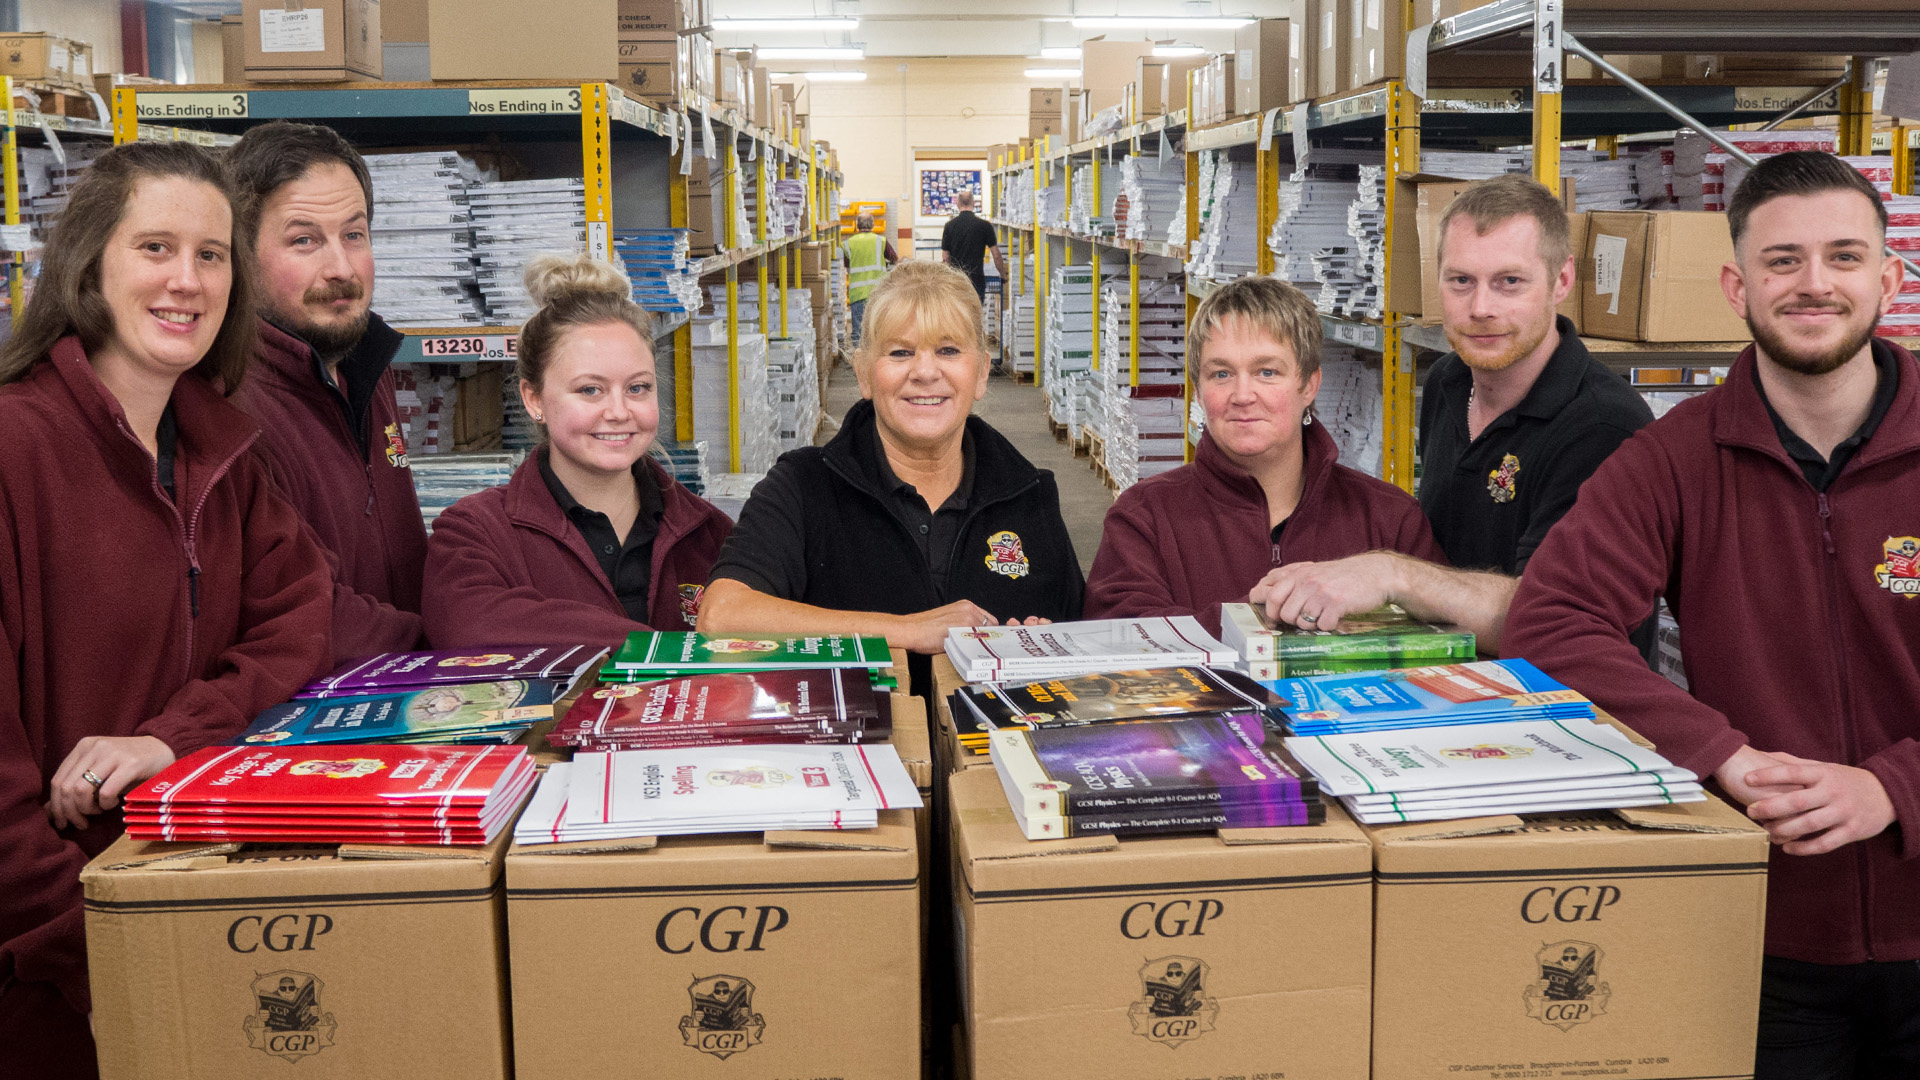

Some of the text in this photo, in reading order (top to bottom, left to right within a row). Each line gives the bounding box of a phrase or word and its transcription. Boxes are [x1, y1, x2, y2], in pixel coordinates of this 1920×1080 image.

[217, 106, 230, 115] in
[232, 94, 246, 116] 3
[469, 90, 582, 114] Nos Ending in 3
[1825, 89, 1838, 108] 3
[424, 338, 484, 354] 13230
[1000, 562, 1024, 574] CGP
[1310, 646, 1332, 654] Biology
[640, 684, 674, 724] GCSE English
[252, 758, 292, 776] Maths
[1381, 746, 1425, 770] Biology
[418, 768, 448, 790] Targeted
[642, 764, 664, 800] KS2 English
[672, 766, 698, 796] Spelling
[801, 766, 825, 786] Year 3
[1074, 761, 1108, 790] GCSE AQA
[1104, 766, 1135, 790] Physics
[842, 782, 861, 801] Targeted
[1094, 800, 1117, 808] Physics
[1099, 822, 1121, 830] Physics
[1141, 818, 1171, 827] Complete
[1520, 885, 1621, 924] CGP
[1120, 899, 1224, 940] CGP
[227, 914, 334, 954] CGP
[655, 906, 789, 954] CGP
[1546, 1004, 1589, 1021] CGP
[1152, 1020, 1197, 1038] CGP
[270, 1034, 315, 1052] CGP
[702, 1033, 744, 1049] CGP
[1448, 1064, 1463, 1072] CGP
[1464, 1064, 1495, 1072] Customer
